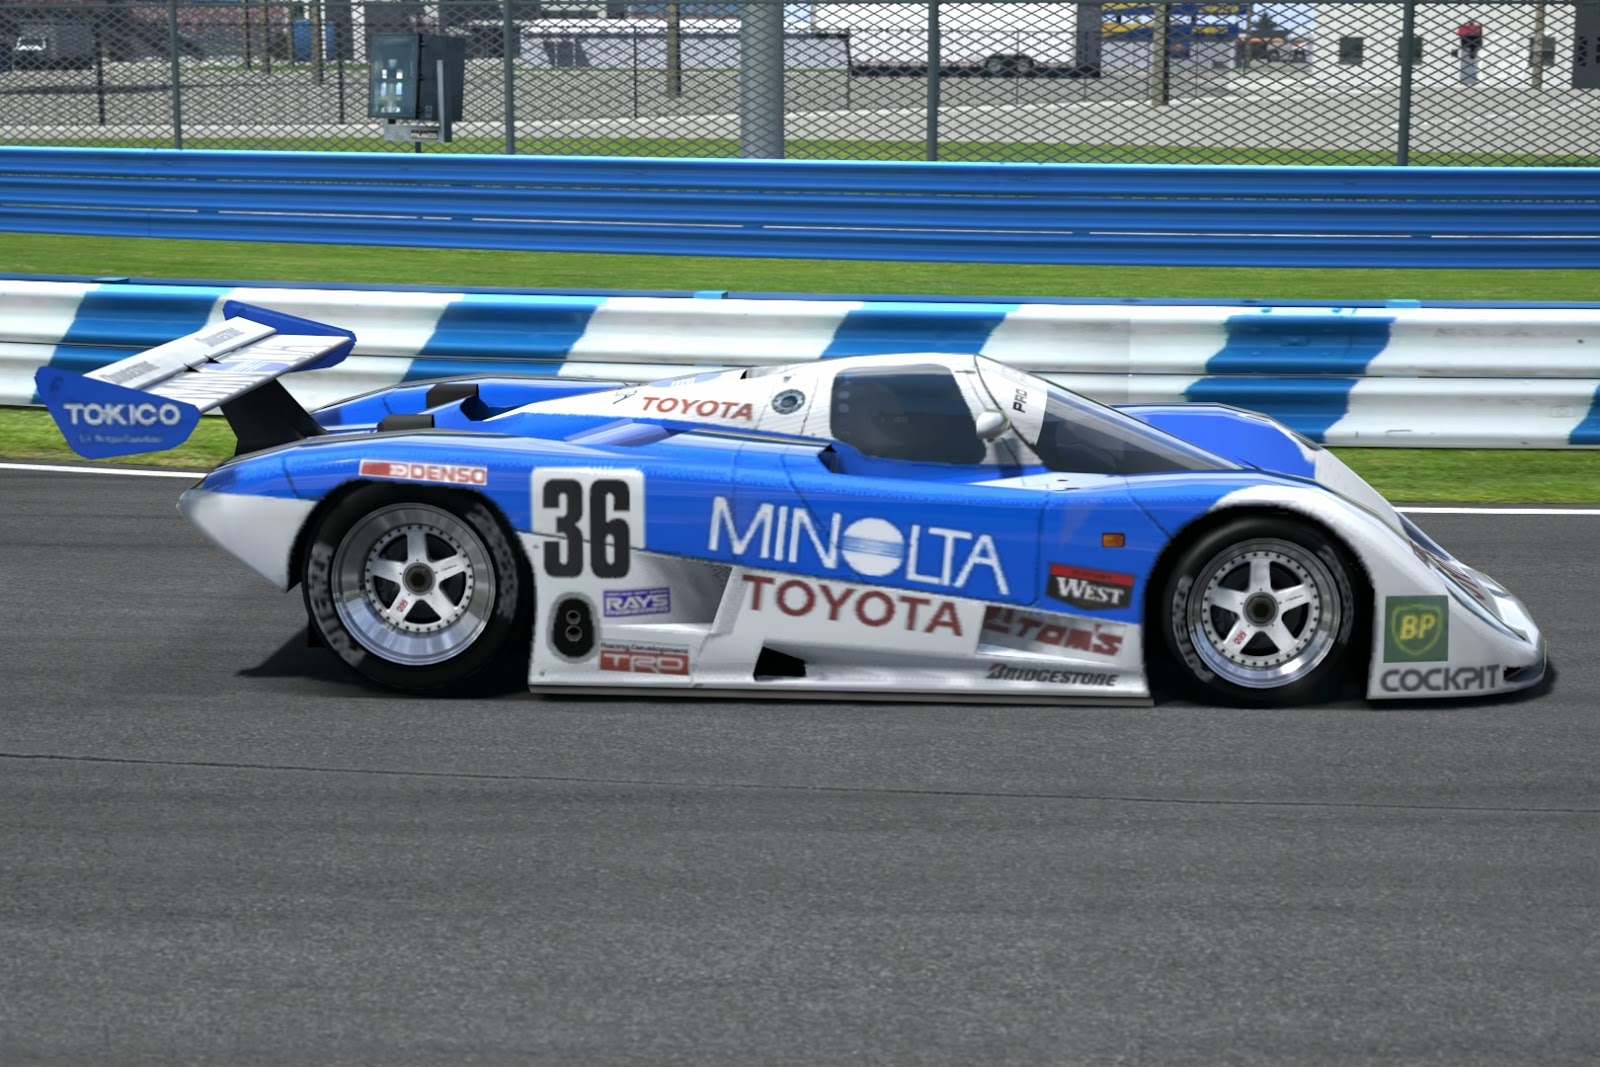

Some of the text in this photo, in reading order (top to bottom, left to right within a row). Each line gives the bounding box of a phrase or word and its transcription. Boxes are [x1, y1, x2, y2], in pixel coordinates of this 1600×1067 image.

[643, 396, 753, 421] TOYOTA
[1012, 388, 1028, 414] PRO
[63, 402, 181, 426] TOKICO
[410, 463, 487, 484] DENSO
[542, 478, 631, 579] 36
[708, 496, 1009, 596] MINOLTA
[605, 593, 669, 612] RAYS
[743, 574, 963, 637] TOYOTA
[1400, 613, 1436, 641] BP
[603, 652, 685, 674] TRD
[985, 662, 1119, 687] BRIDGESTONE
[1380, 664, 1500, 692] COCKPIT
